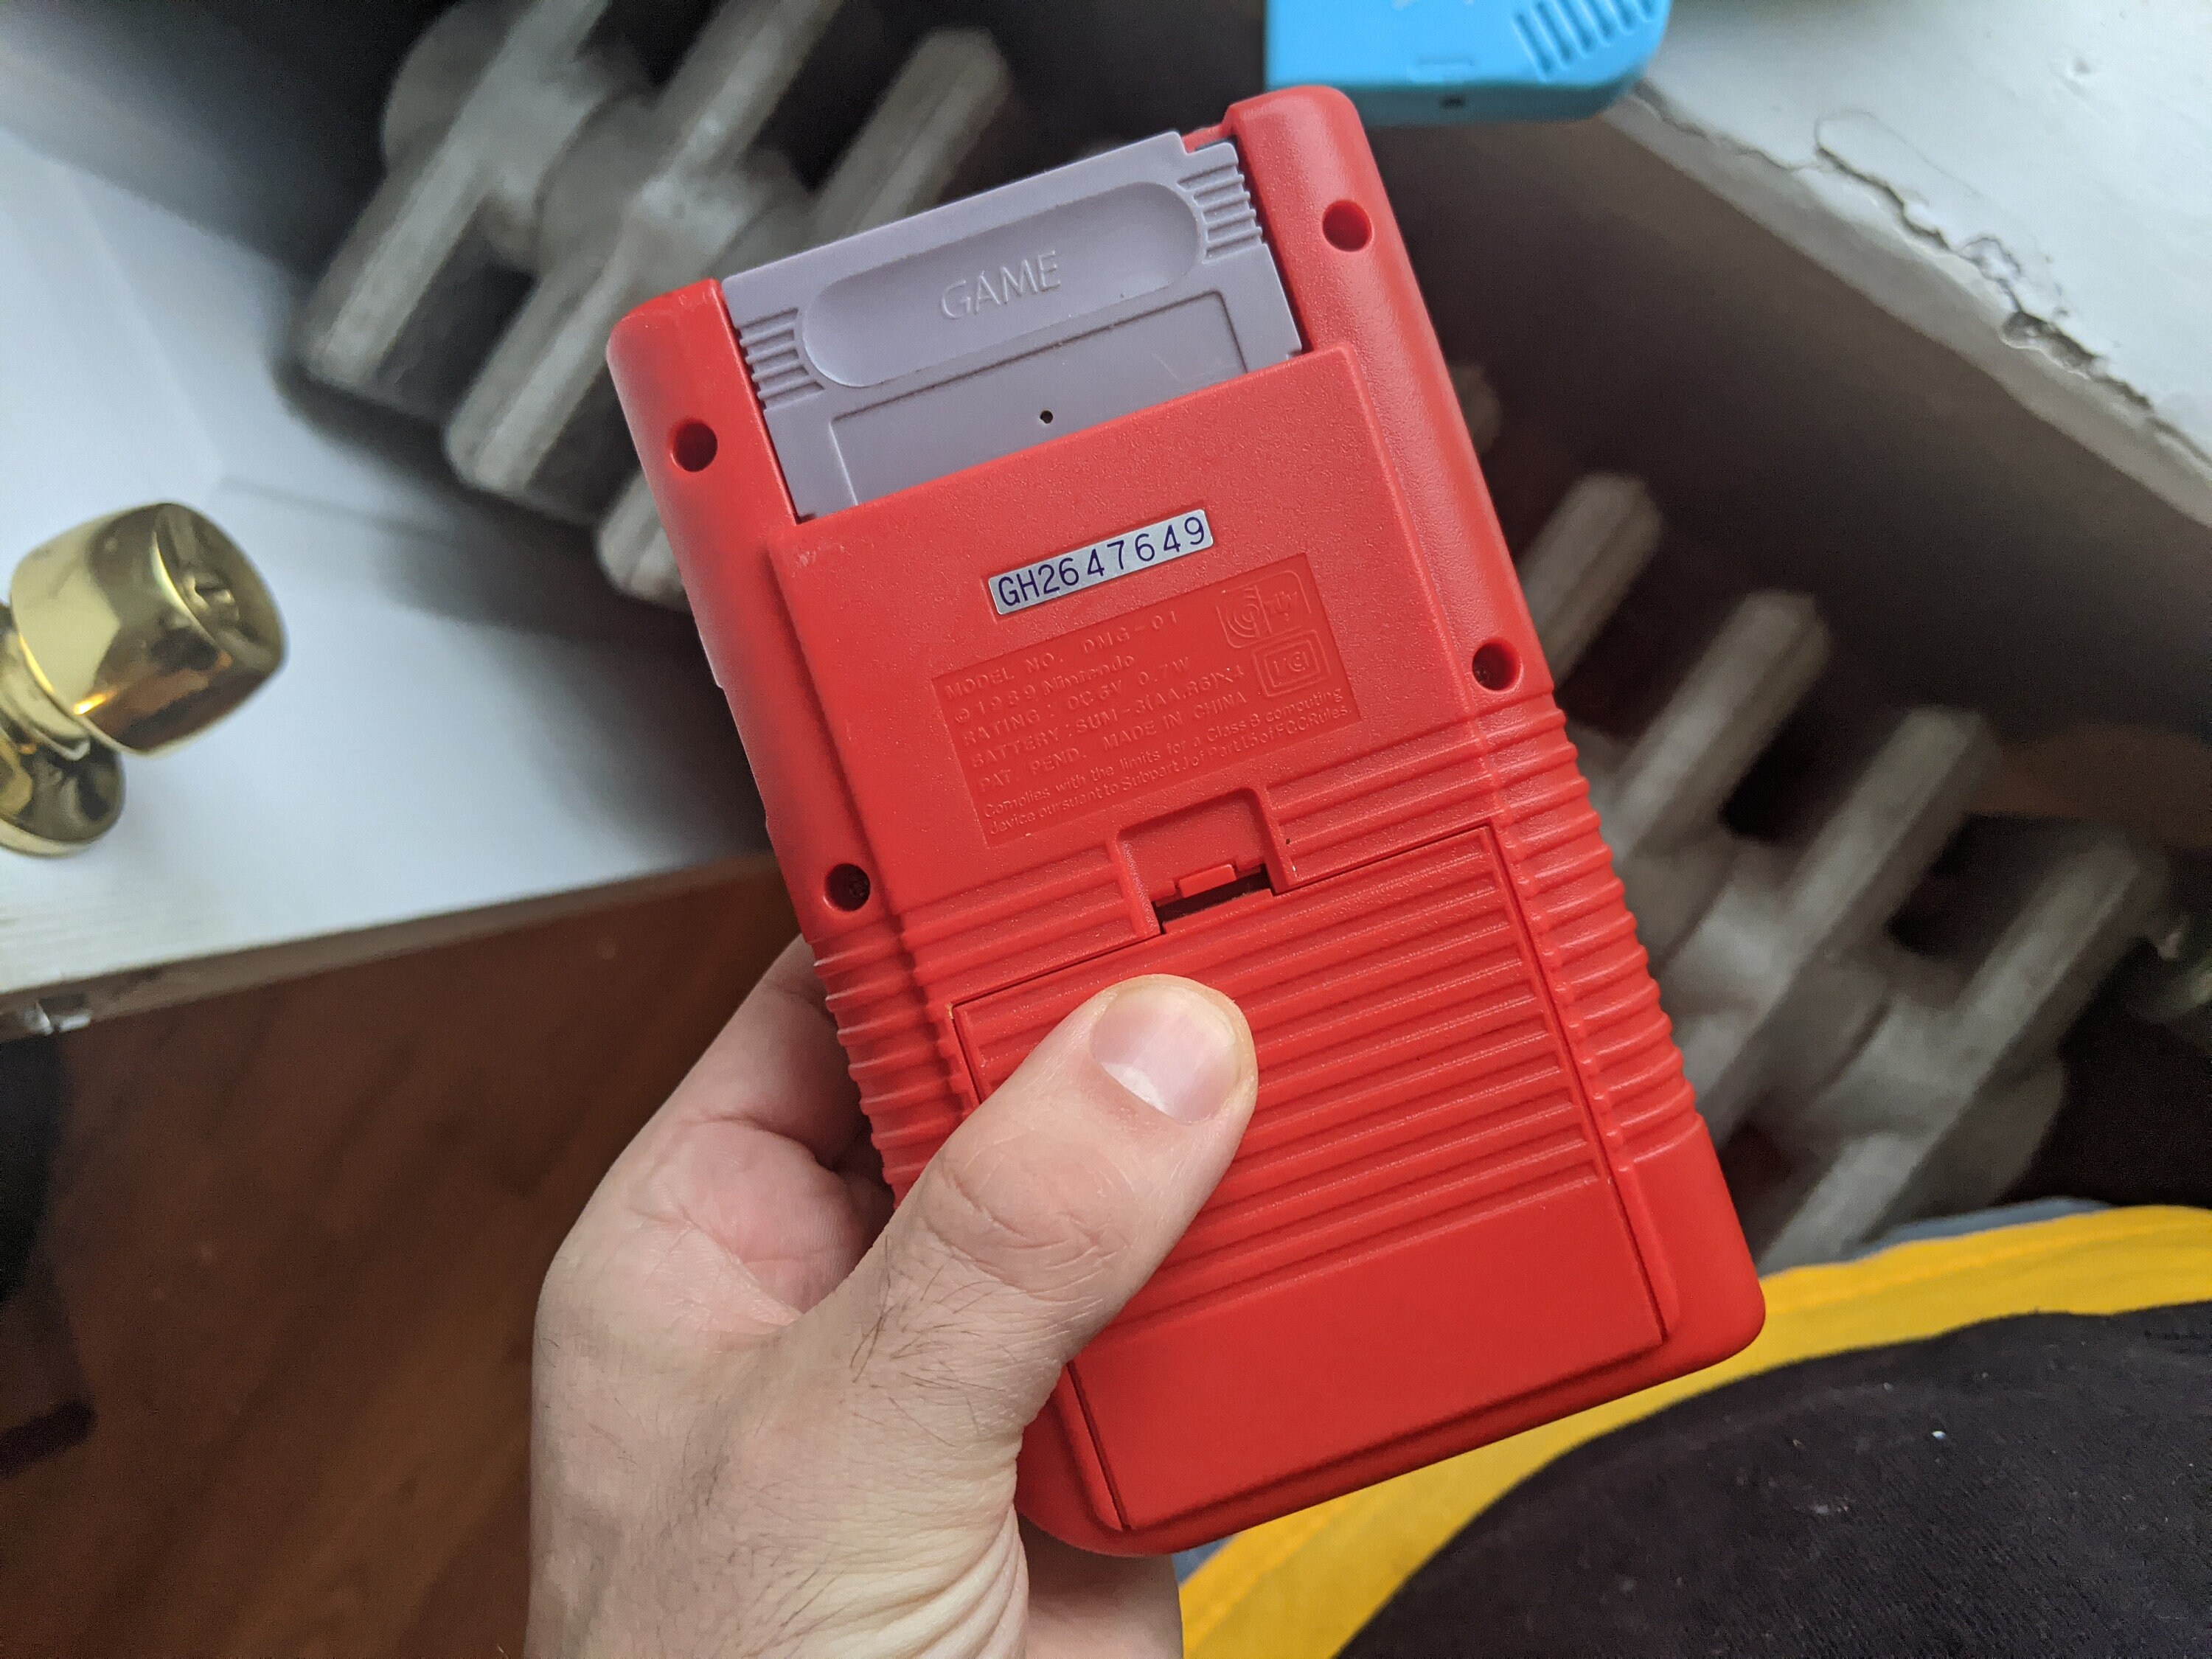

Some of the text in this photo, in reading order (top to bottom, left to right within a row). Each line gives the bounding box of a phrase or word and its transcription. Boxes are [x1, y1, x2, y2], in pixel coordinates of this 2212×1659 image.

[939, 249, 1061, 320] GAME
[997, 516, 1205, 607] GH2647649
[946, 666, 1015, 698] MODEL
[1026, 650, 1062, 672] NO.
[1042, 653, 1135, 694] Nintendo
[984, 785, 1051, 817] Complies
[1055, 773, 1087, 793] with
[1091, 764, 1115, 782] the
[1121, 748, 1161, 772] limits
[1167, 738, 1188, 756] for
[1206, 719, 1247, 742] Class
[1264, 686, 1343, 722] computing
[1102, 721, 1157, 750] MADE
[1164, 712, 1182, 729] IN
[1193, 691, 1247, 720] CHINA
